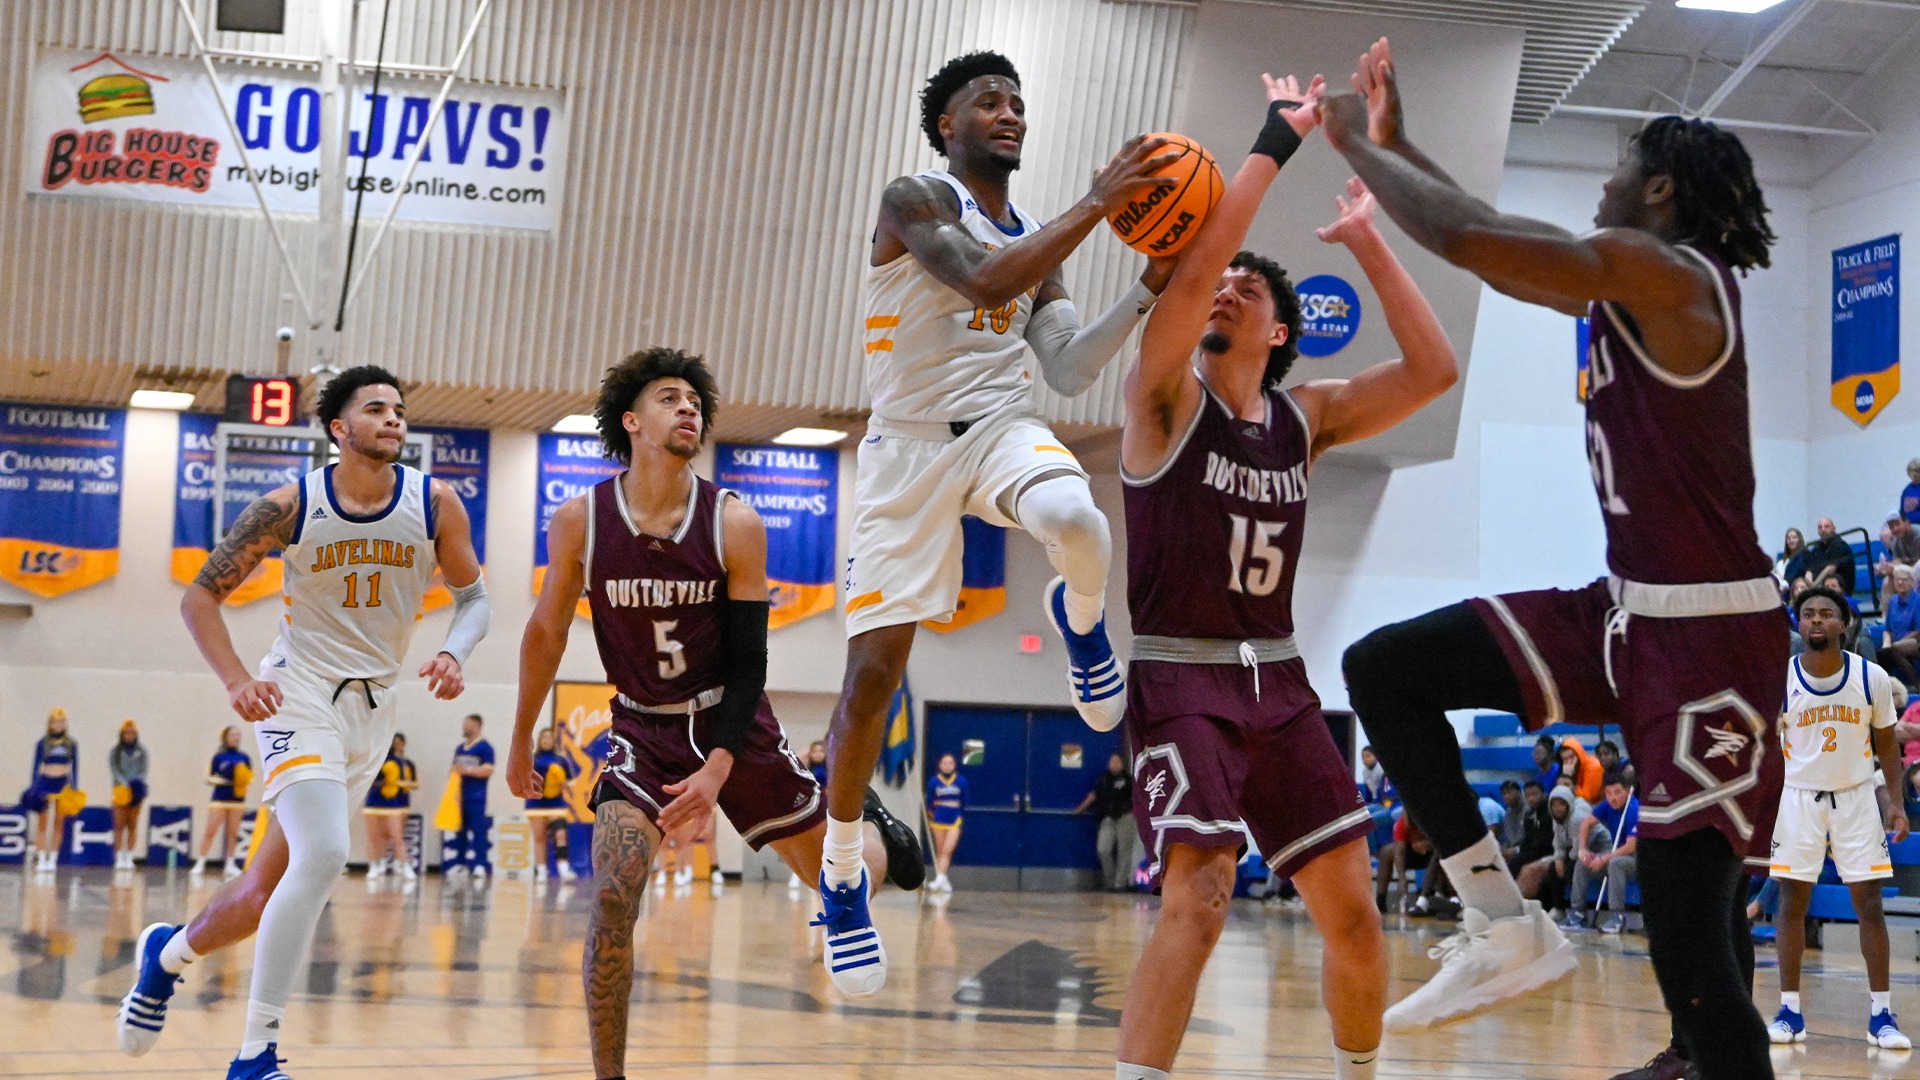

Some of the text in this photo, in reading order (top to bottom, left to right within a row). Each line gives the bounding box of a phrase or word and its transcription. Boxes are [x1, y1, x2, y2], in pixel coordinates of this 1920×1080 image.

[235, 83, 550, 172] GO JAVS!
[127, 130, 217, 163] HOUSE
[1113, 184, 1177, 236] Wilson
[1147, 211, 1196, 253] NCAA
[1837, 275, 1894, 309] CHAMPIONS
[1321, 323, 1350, 333] STAR
[8, 408, 111, 430] FOOTBALL
[251, 380, 292, 426] 13
[0, 450, 116, 479] CHAMPIONS
[733, 450, 821, 470] SOFTBALL
[1202, 451, 1308, 508] DUSTDEVILS
[735, 488, 827, 515] HAMPIONS
[311, 538, 415, 573] JAVELINAS
[1228, 513, 1288, 597] 15
[342, 572, 381, 608] 11
[652, 619, 687, 680] 5
[1796, 703, 1861, 727] JAVELINAS
[1822, 727, 1837, 752] 2
[150, 818, 190, 854] A
